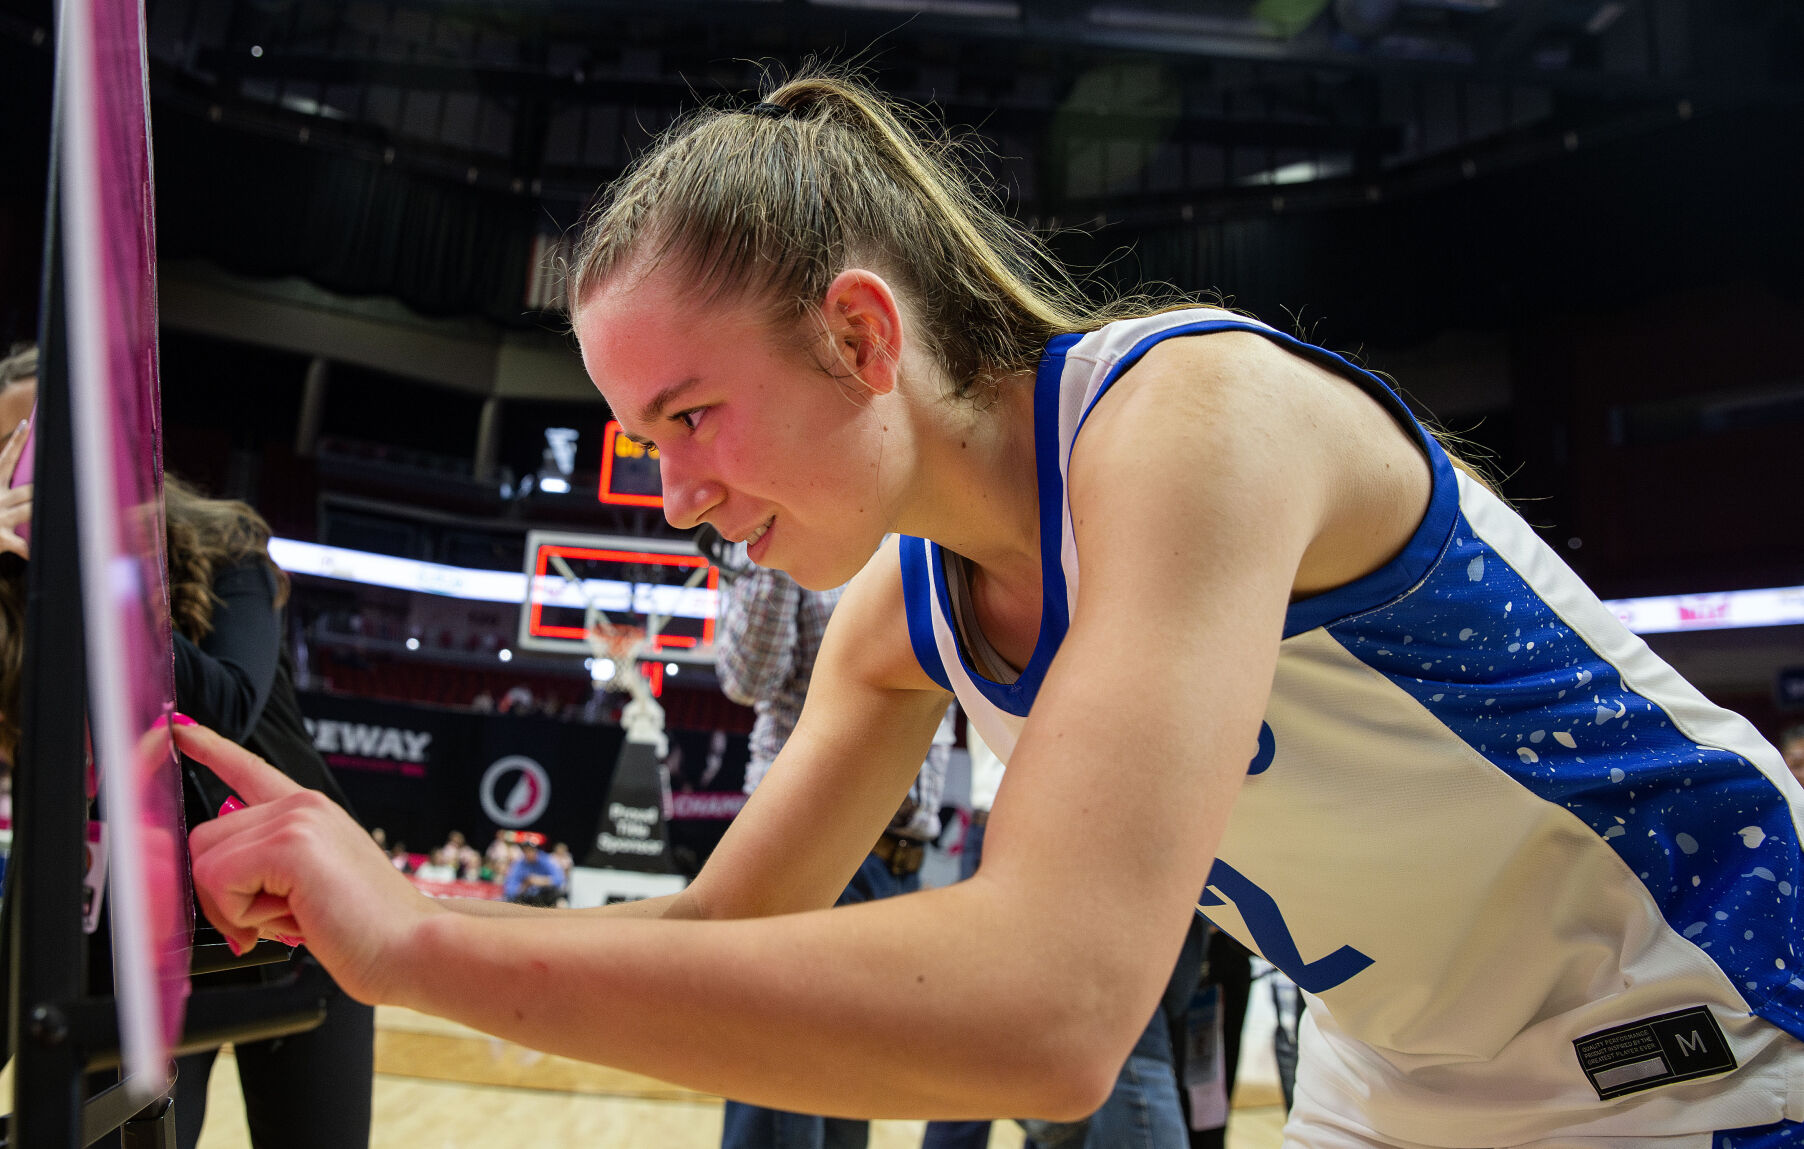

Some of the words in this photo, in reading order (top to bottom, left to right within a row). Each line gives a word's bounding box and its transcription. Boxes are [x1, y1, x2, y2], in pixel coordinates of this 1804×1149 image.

[608, 802, 659, 825] Proud
[616, 818, 651, 839] Title
[597, 831, 664, 856] Sponsor
[1582, 1041, 1604, 1053] QUALITY
[1605, 1029, 1650, 1046] PERFORMANCE
[1584, 1047, 1607, 1059] PRODUCT
[1607, 1042, 1633, 1053] INSPIRED
[1674, 1029, 1708, 1057] M
[1587, 1053, 1615, 1065] GREATEST
[1616, 1046, 1639, 1057] PLAYER
[1639, 1042, 1656, 1053] EVER
